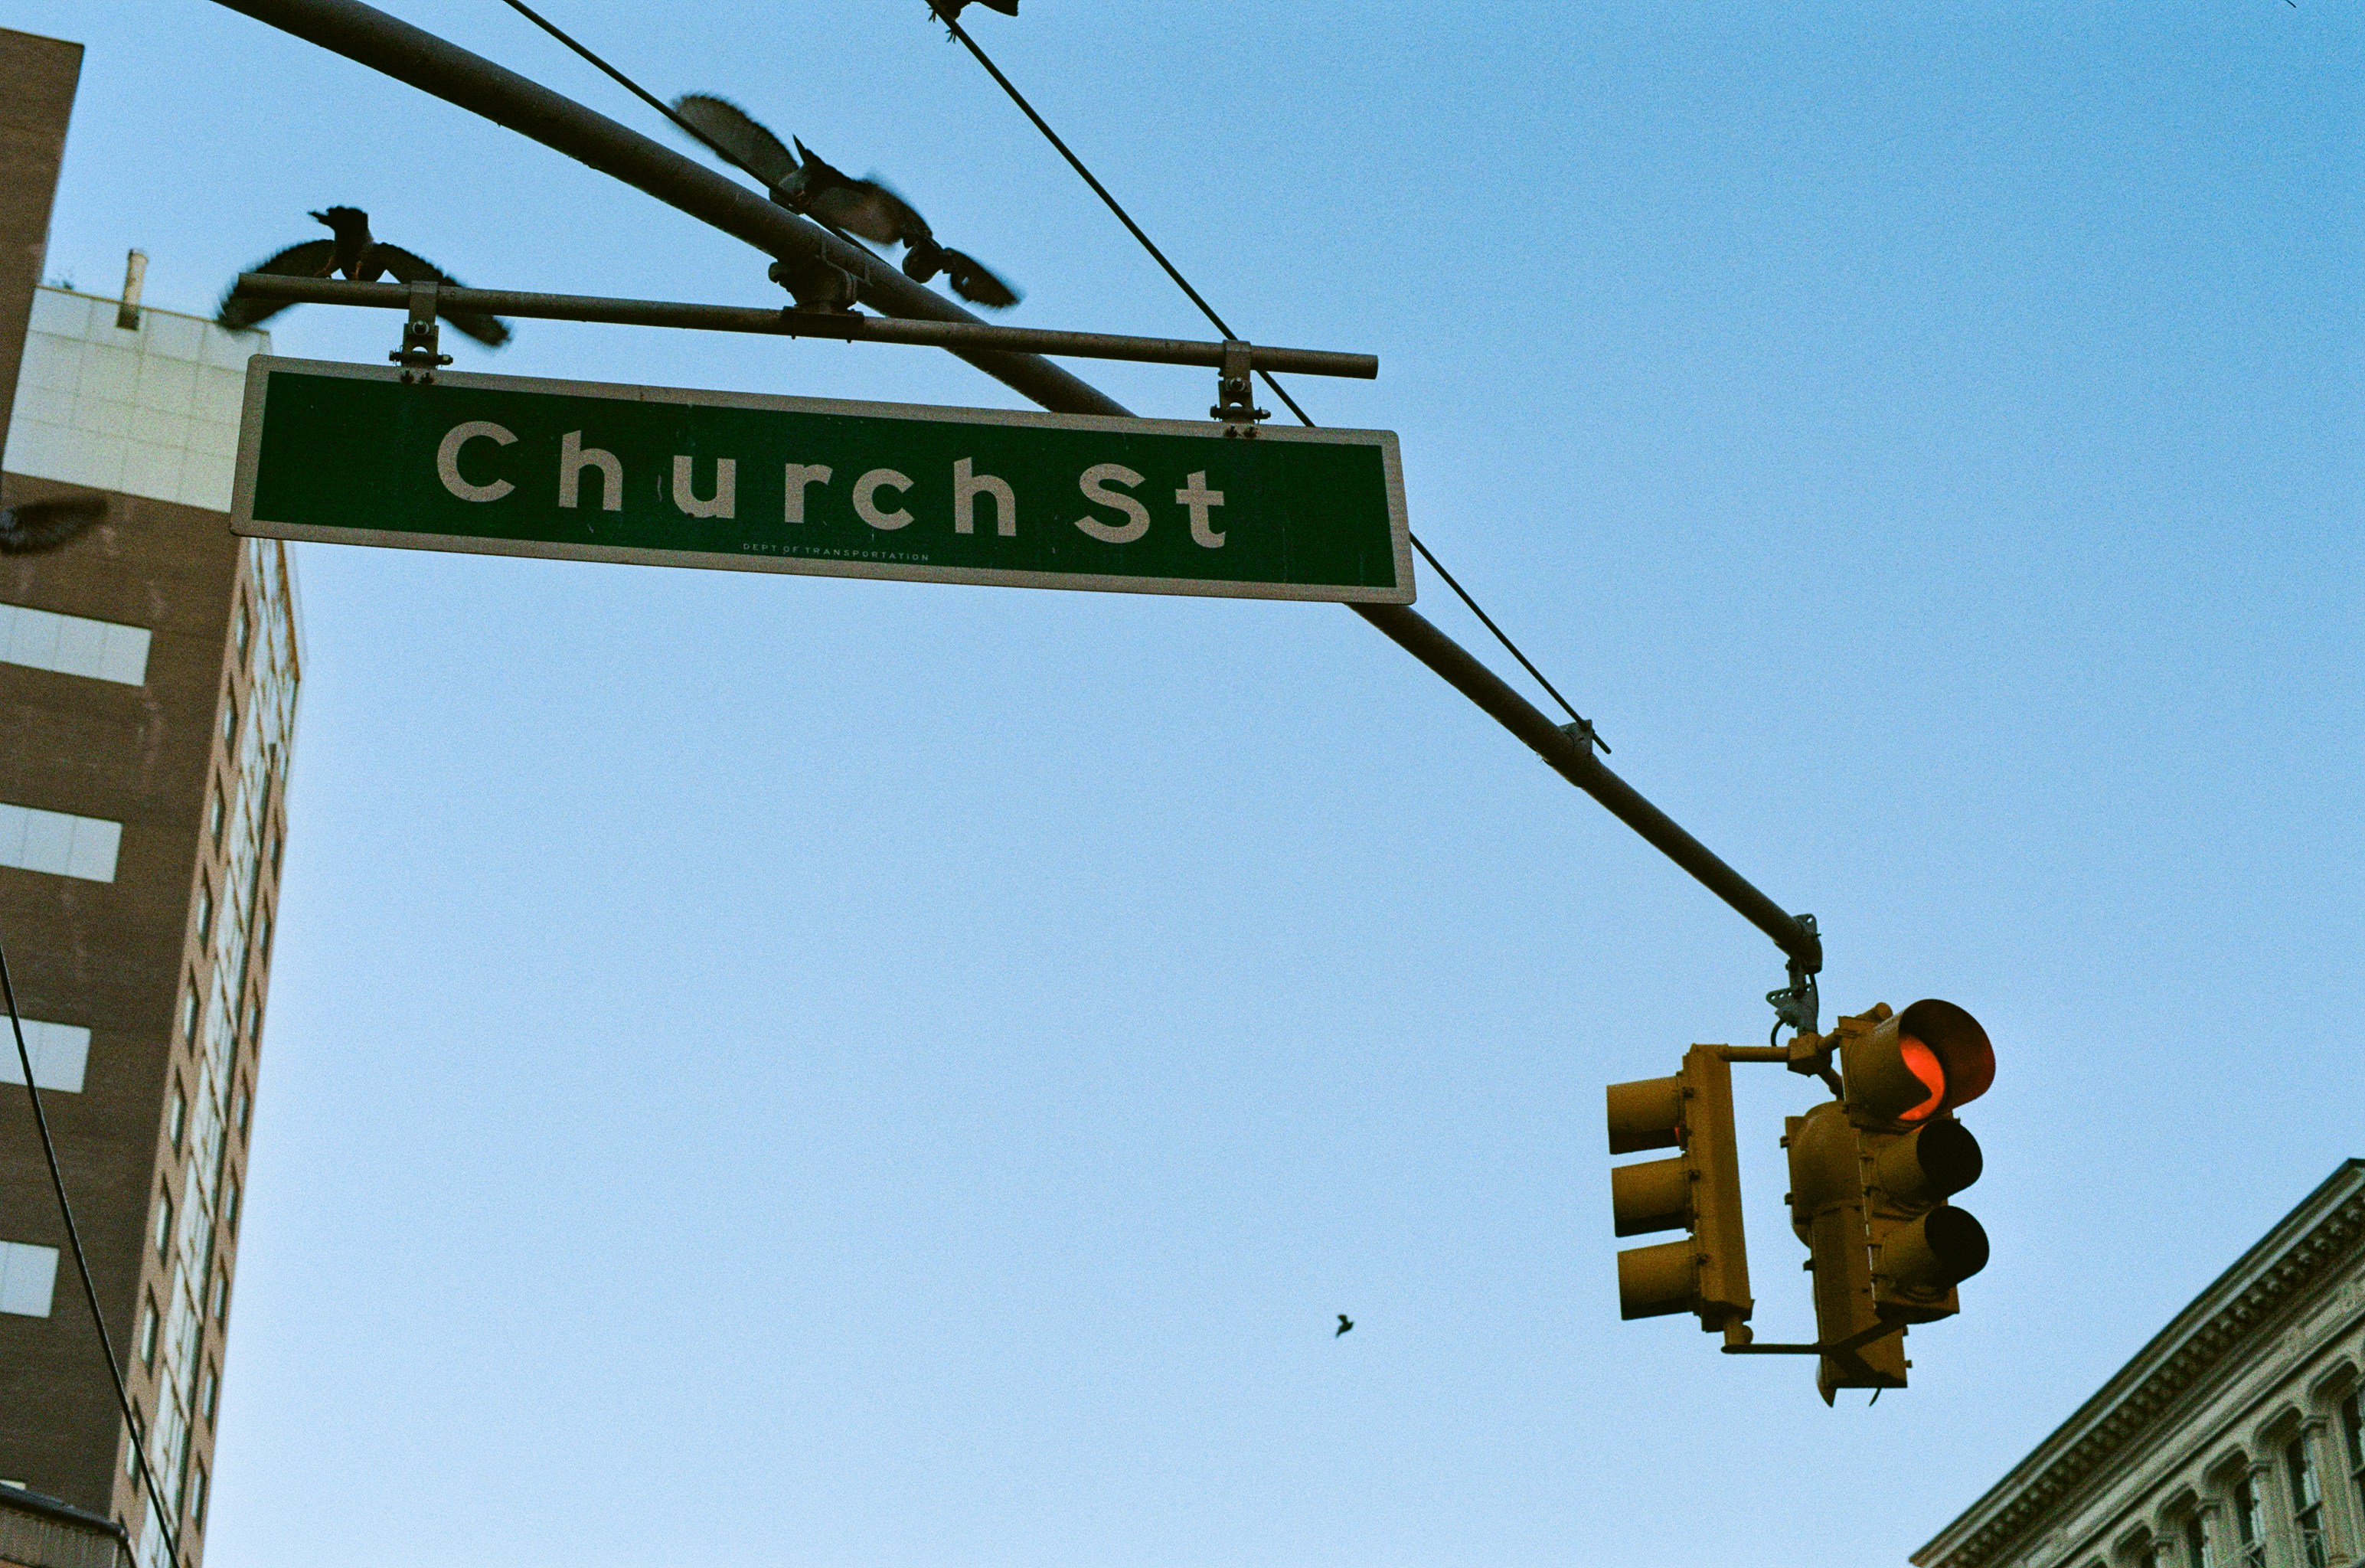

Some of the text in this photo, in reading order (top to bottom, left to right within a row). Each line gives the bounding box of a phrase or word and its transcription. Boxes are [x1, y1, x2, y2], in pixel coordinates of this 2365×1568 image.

[436, 420, 1227, 549] Church St
[743, 543, 929, 560] DEPT OF TRANSPORTATION
